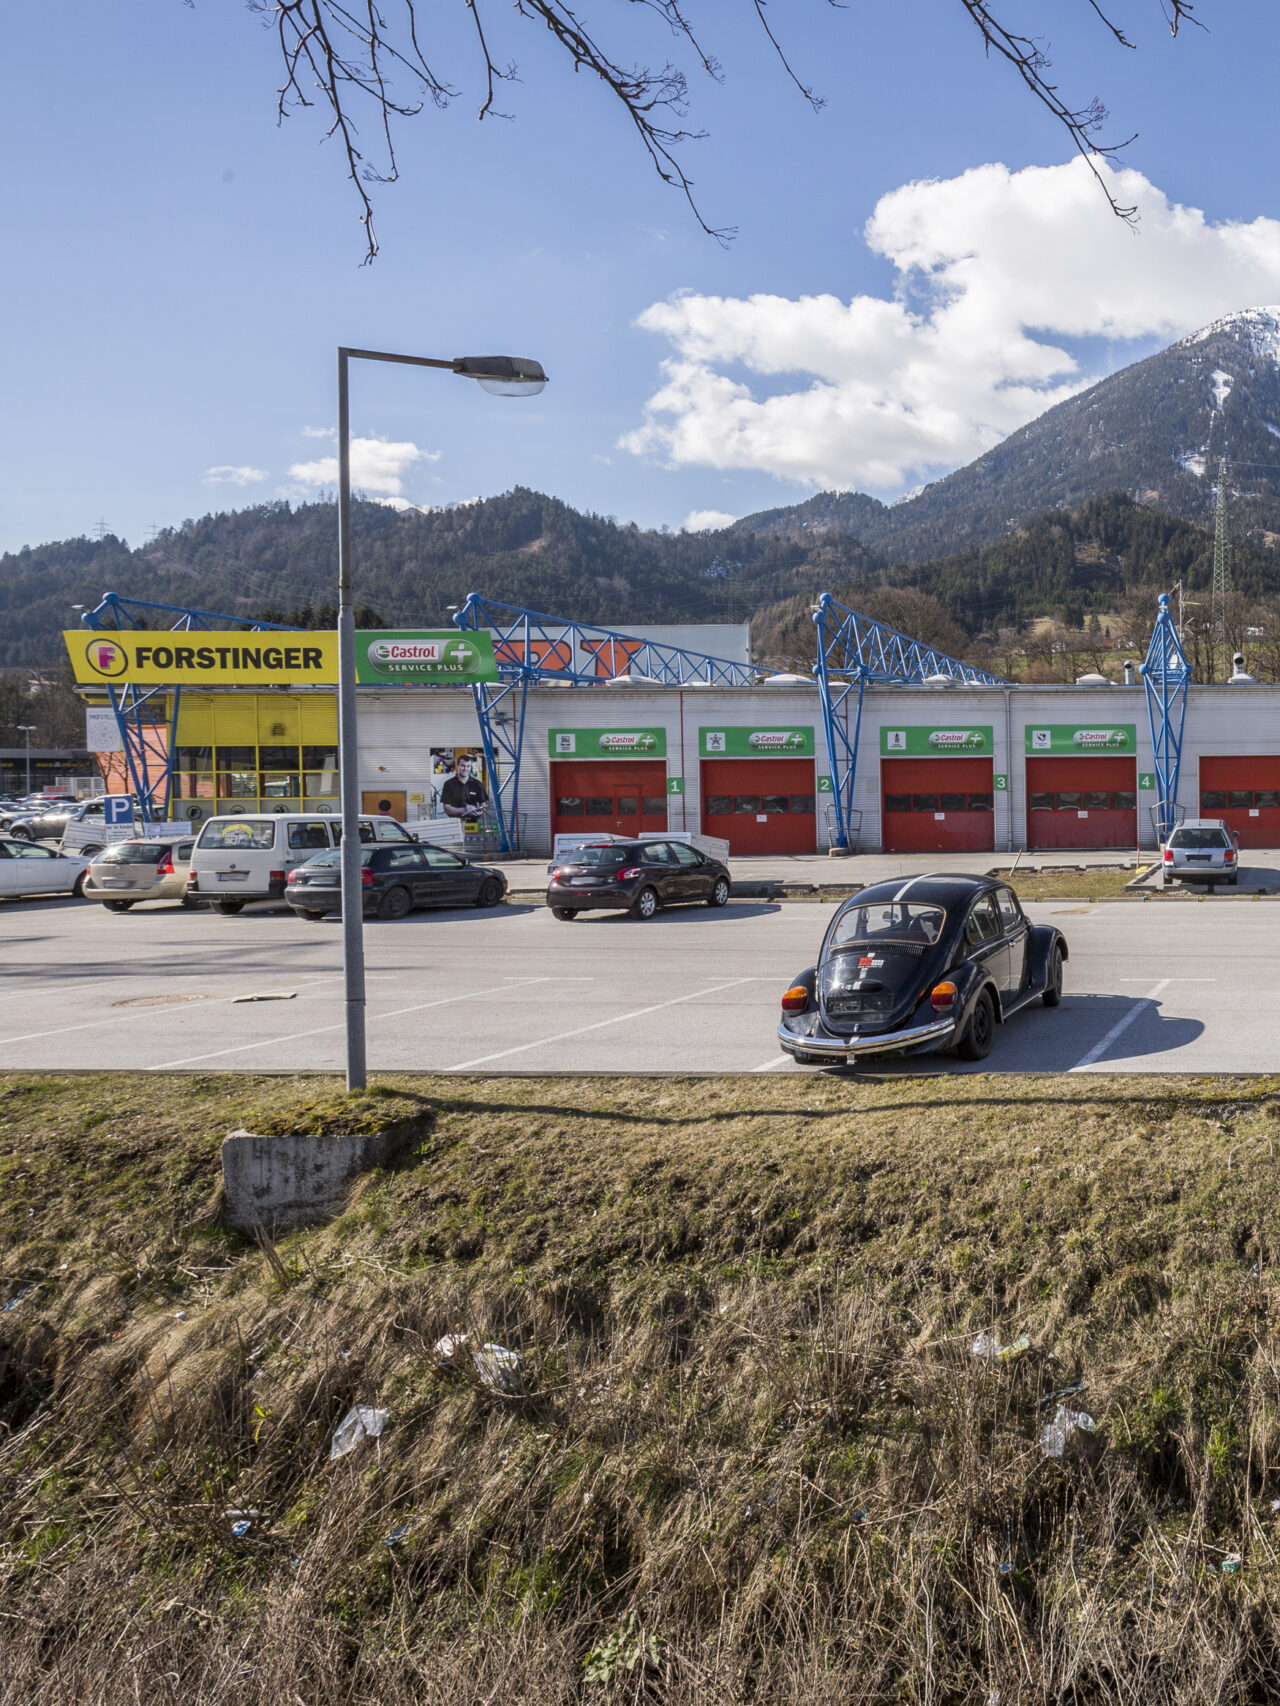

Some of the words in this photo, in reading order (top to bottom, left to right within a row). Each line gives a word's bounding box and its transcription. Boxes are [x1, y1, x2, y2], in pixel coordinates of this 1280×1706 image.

[391, 645, 436, 658] Castrol
[136, 647, 323, 670] FORSTINGER
[388, 664, 433, 672] SERVICE
[611, 736, 635, 744] Castrol
[760, 735, 784, 743] Castrol
[940, 734, 964, 742] Castrol
[1084, 733, 1108, 741] Castrol
[670, 781, 680, 792] 1
[820, 779, 830, 790] 2
[996, 777, 1006, 788] 3
[1141, 776, 1151, 787] 4
[112, 798, 130, 823] P
